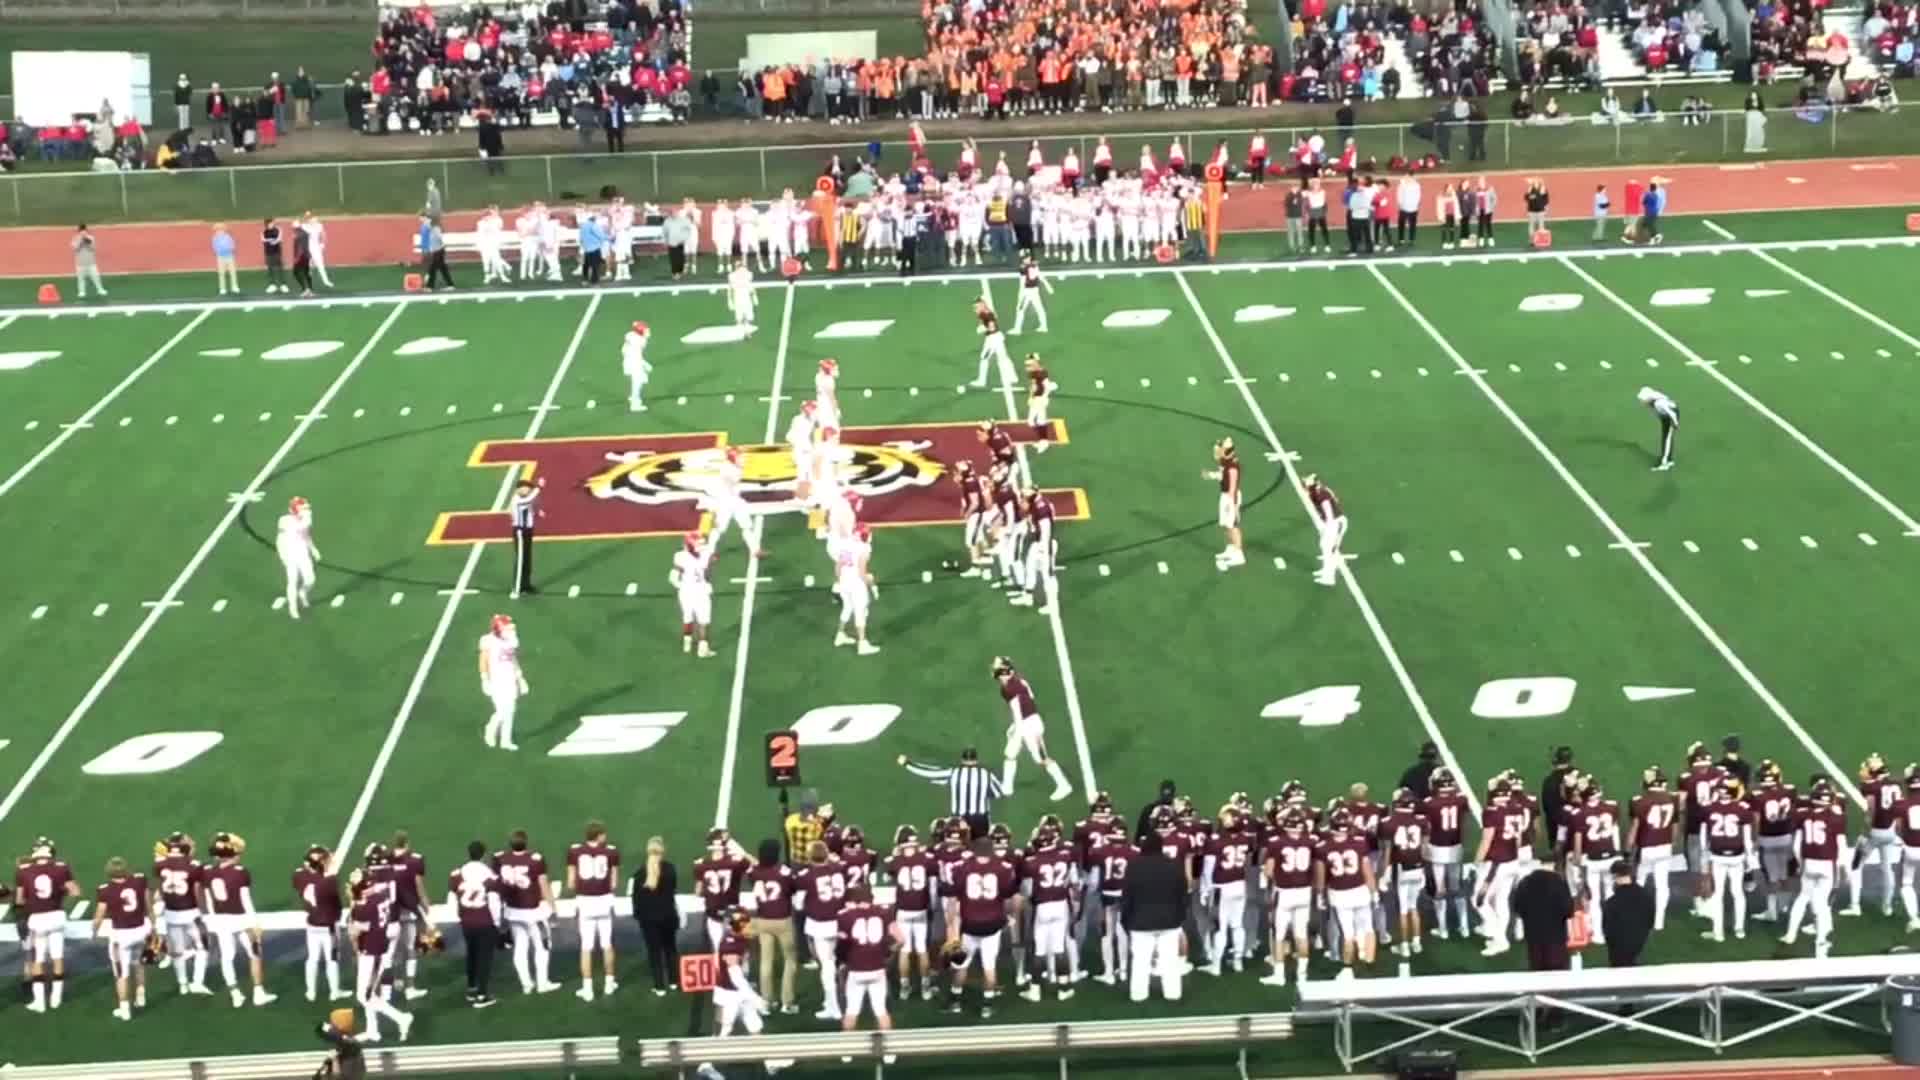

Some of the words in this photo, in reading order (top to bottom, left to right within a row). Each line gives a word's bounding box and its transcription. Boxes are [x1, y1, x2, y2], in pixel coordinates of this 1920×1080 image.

[769, 735, 796, 768] 2
[1440, 805, 1458, 831] 11
[1586, 813, 1613, 841] 23
[1394, 825, 1422, 850] 43
[1105, 856, 1128, 880] 13
[1221, 844, 1249, 870] 35
[1328, 849, 1359, 876] 33
[34, 874, 52, 899] 9
[160, 868, 189, 895] 25
[704, 869, 732, 895] 37
[816, 873, 845, 902] 59
[1039, 861, 1068, 888] 32
[119, 888, 137, 913] 3
[684, 958, 711, 988] 50
